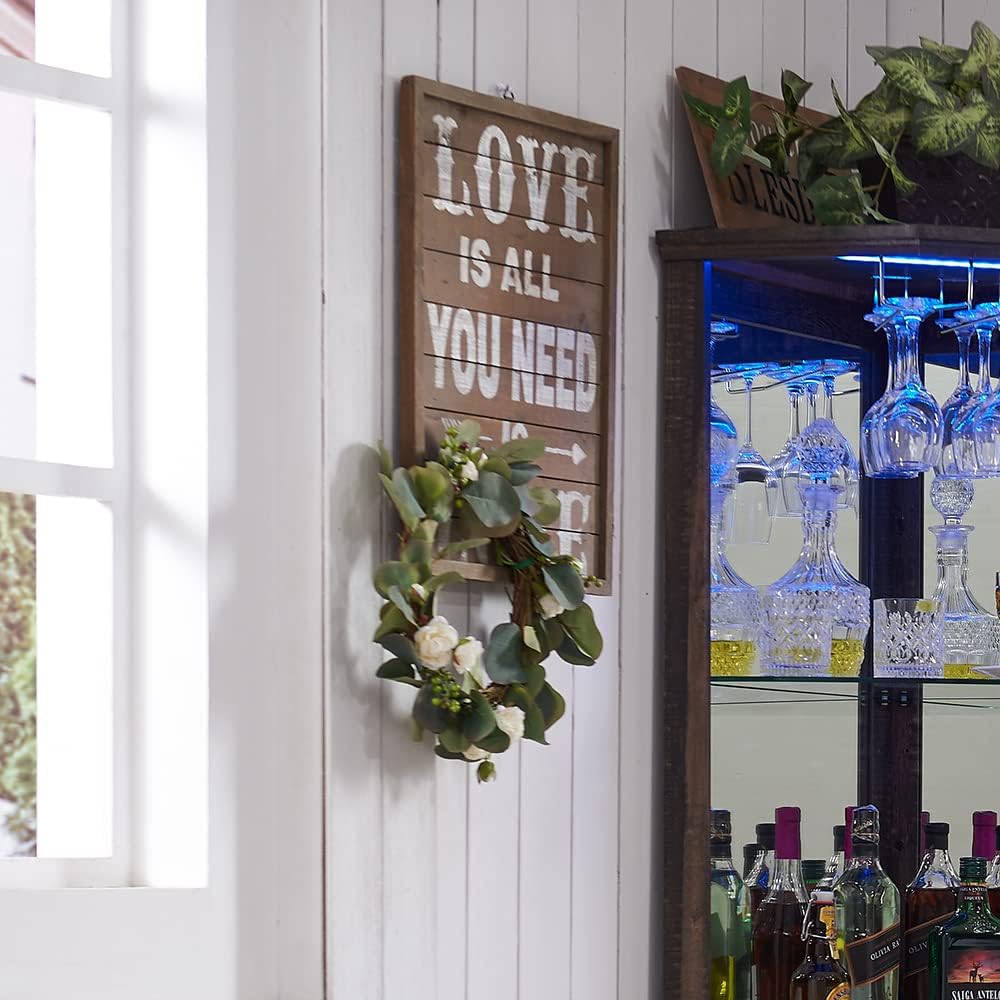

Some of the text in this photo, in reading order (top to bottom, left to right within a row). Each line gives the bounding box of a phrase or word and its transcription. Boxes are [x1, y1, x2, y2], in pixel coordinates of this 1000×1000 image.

[432, 113, 597, 244] LOVE
[459, 235, 560, 303] IS ALL
[426, 302, 597, 413] YOU NEED
[870, 945, 891, 961] OLIVIA
